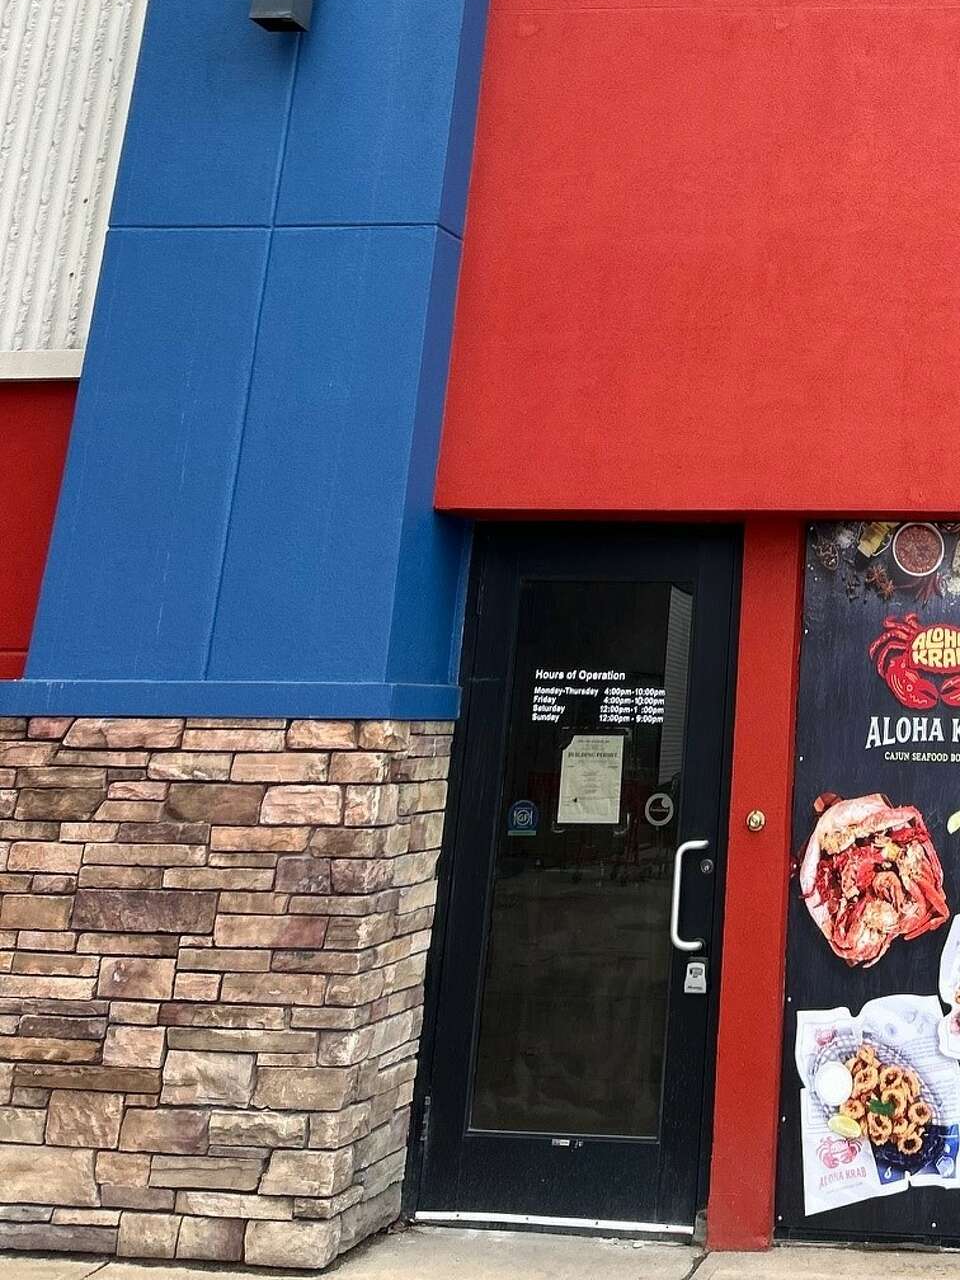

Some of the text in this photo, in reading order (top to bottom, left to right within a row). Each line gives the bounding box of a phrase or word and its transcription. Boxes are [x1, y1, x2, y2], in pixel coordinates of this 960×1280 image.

[535, 669, 626, 682] Hours of Operation
[533, 695, 557, 705] Friday
[532, 704, 566, 714] Saturday
[531, 713, 561, 723] Sunday
[865, 716, 945, 750] ALOHA
[884, 751, 910, 761] CAJUN
[911, 752, 949, 762] SEAFOOD
